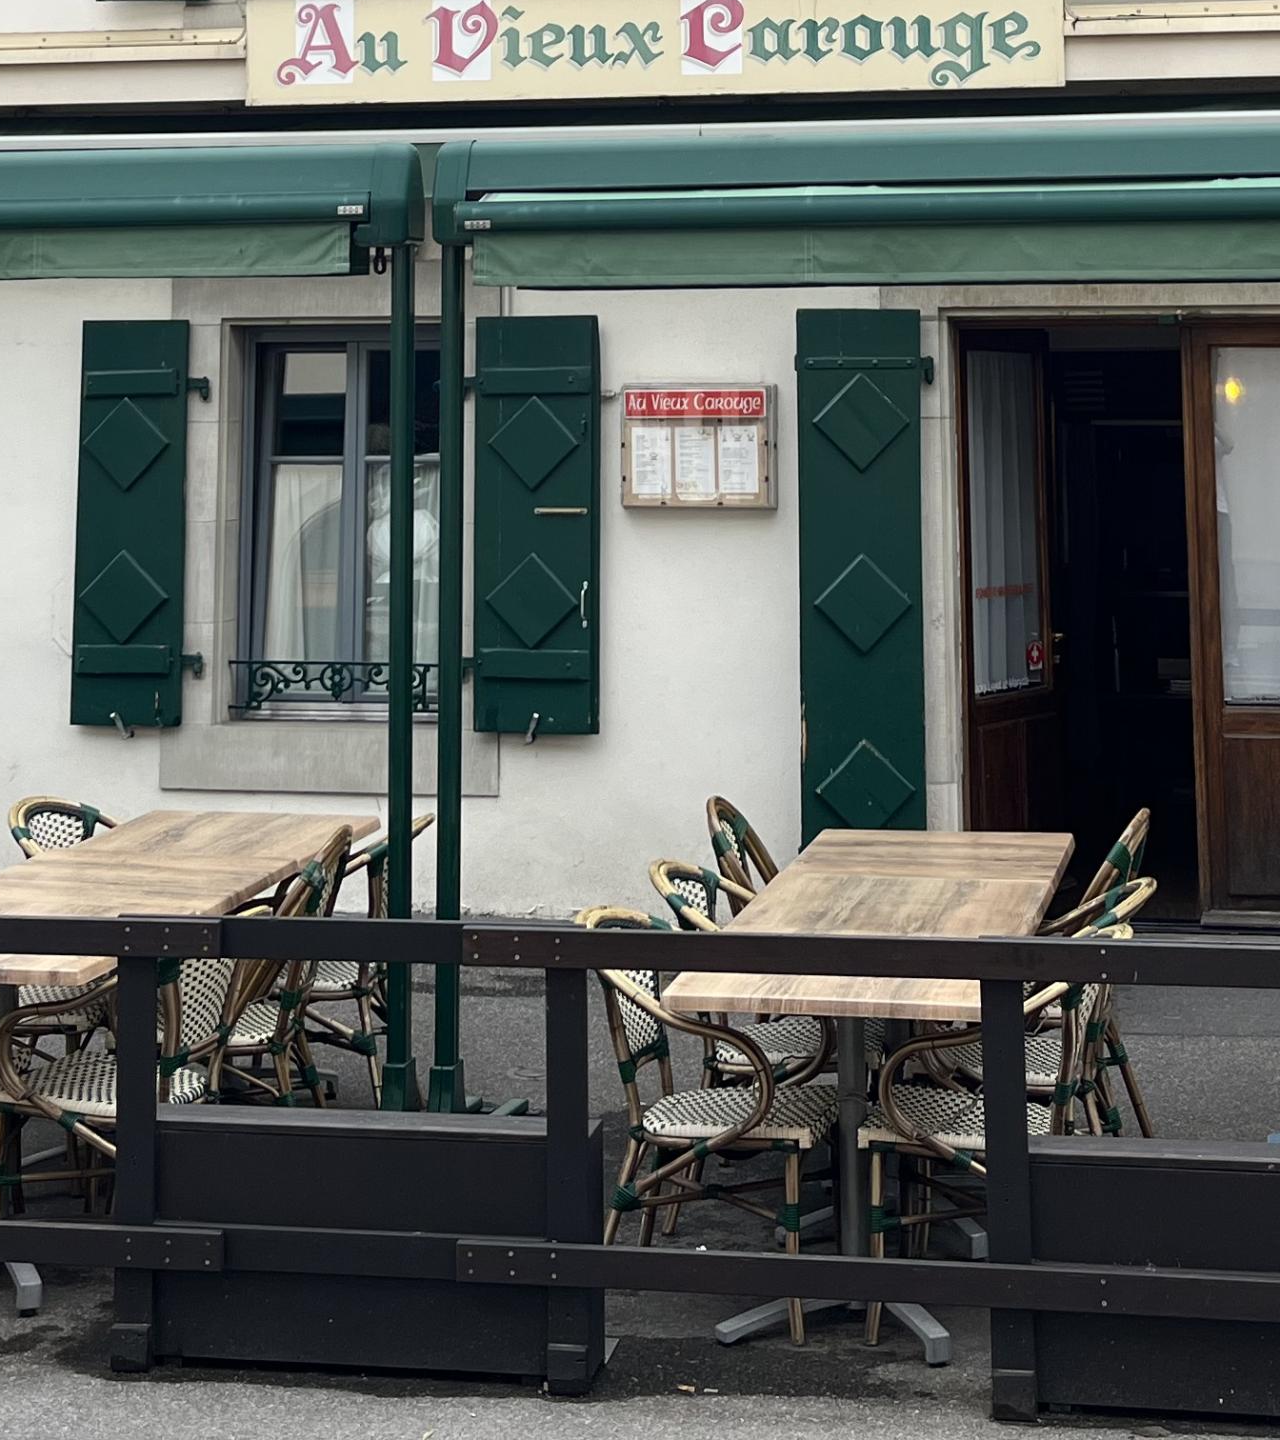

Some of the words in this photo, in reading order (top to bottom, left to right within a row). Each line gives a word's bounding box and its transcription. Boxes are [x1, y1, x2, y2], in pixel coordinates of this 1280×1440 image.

[277, 3, 407, 85] Au
[425, 0, 663, 74] Vieux
[628, 393, 646, 411] Au
[651, 393, 689, 411] Vieux
